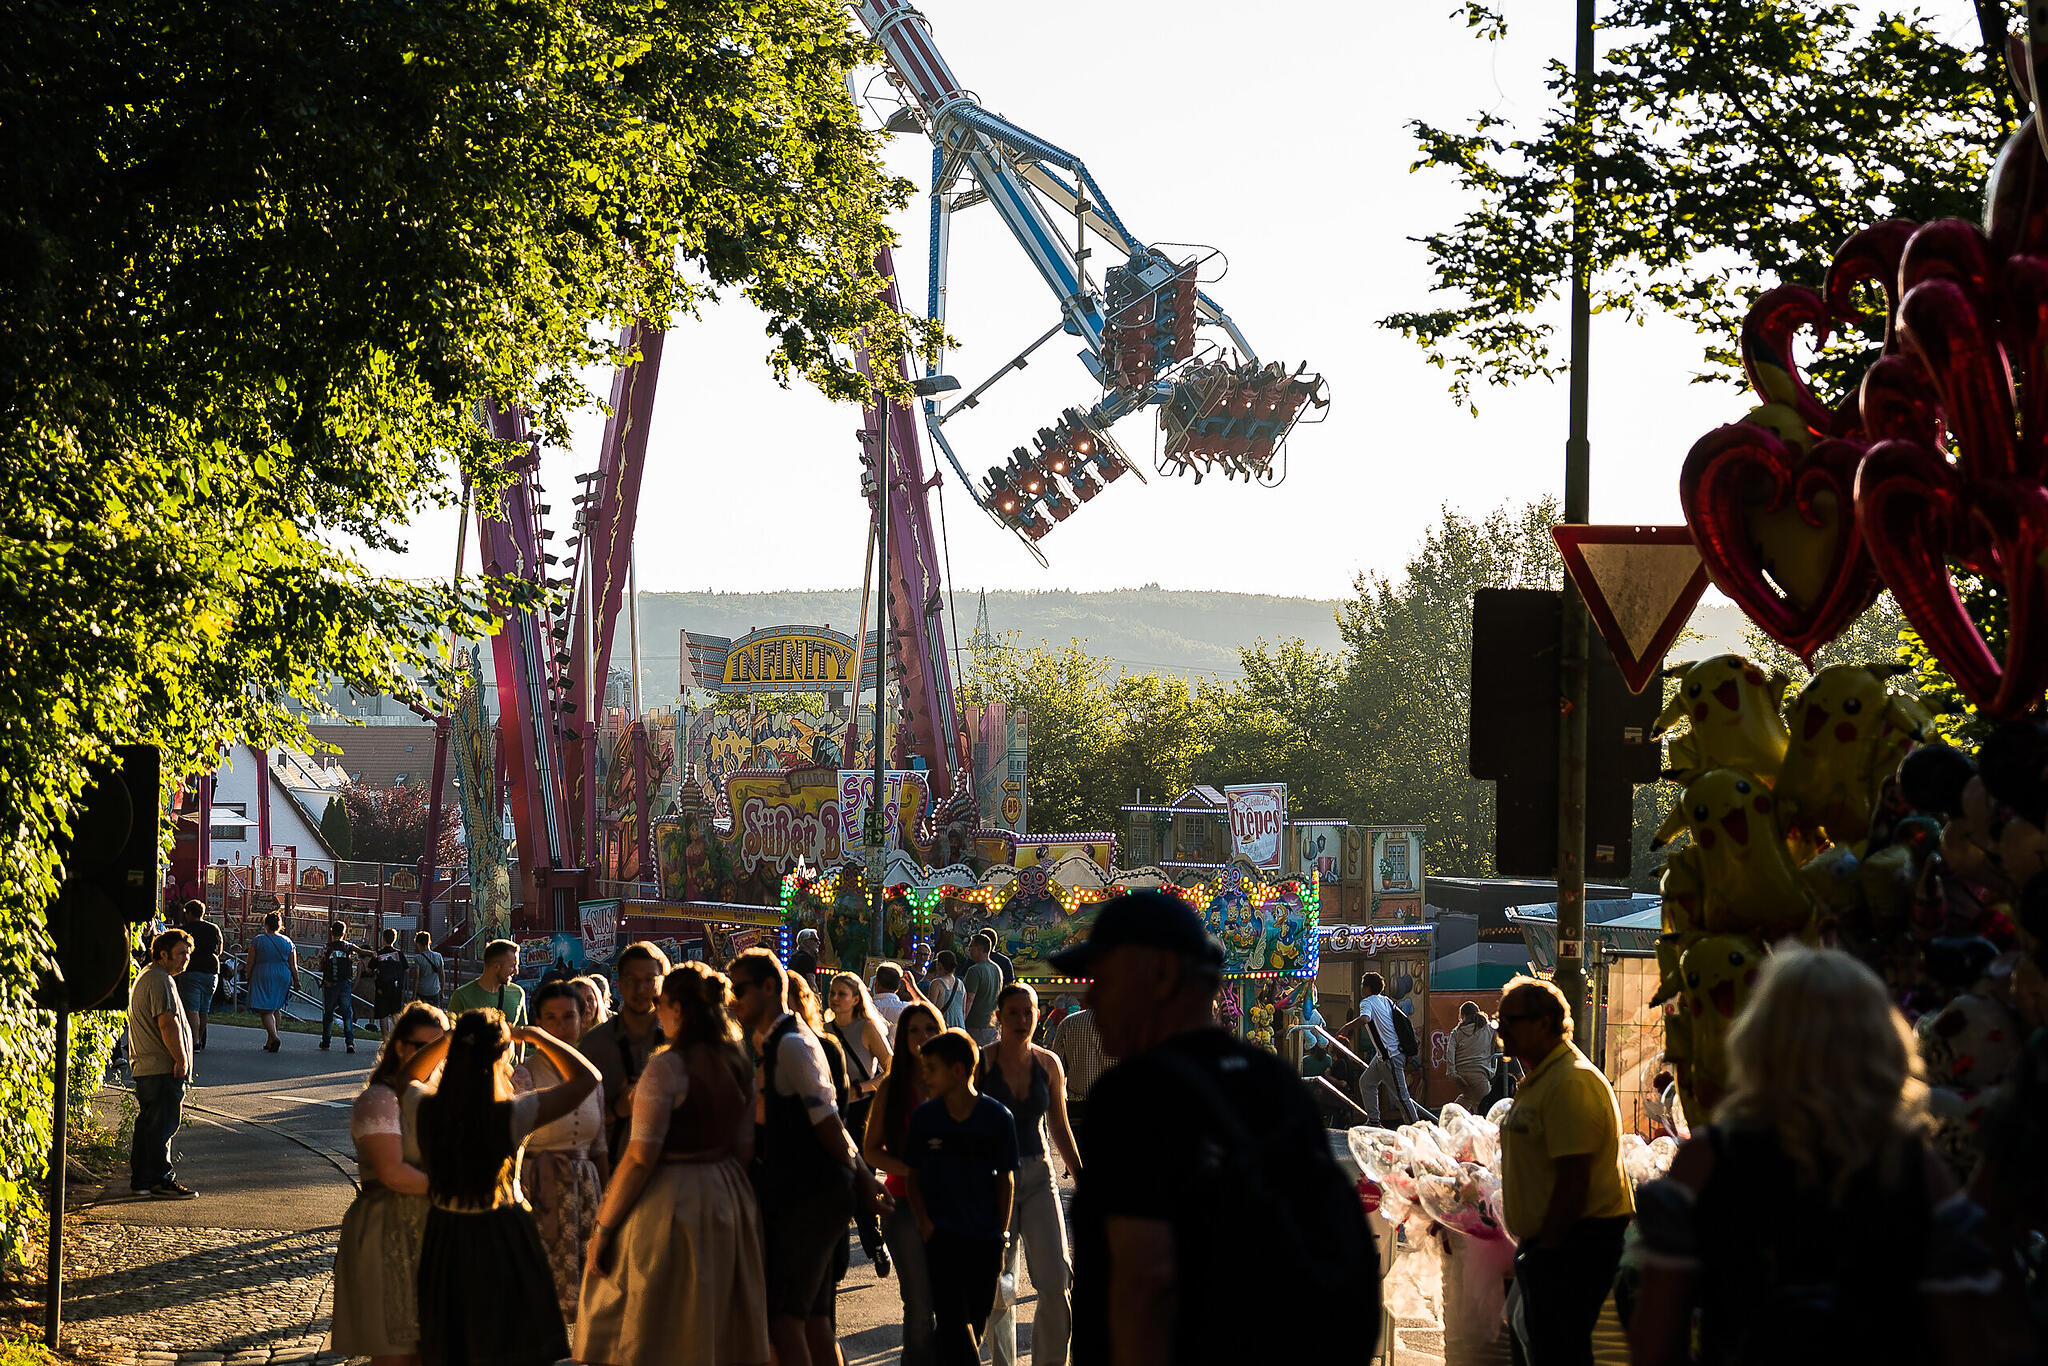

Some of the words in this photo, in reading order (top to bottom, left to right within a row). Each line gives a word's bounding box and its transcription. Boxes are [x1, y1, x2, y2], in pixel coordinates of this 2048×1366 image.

[731, 639, 853, 681] INFINITY
[842, 775, 899, 809] SOT
[743, 800, 818, 869] Süßer
[841, 801, 898, 840] ES
[1231, 806, 1280, 840] Crêpes
[1329, 925, 1401, 957] Crêpe
